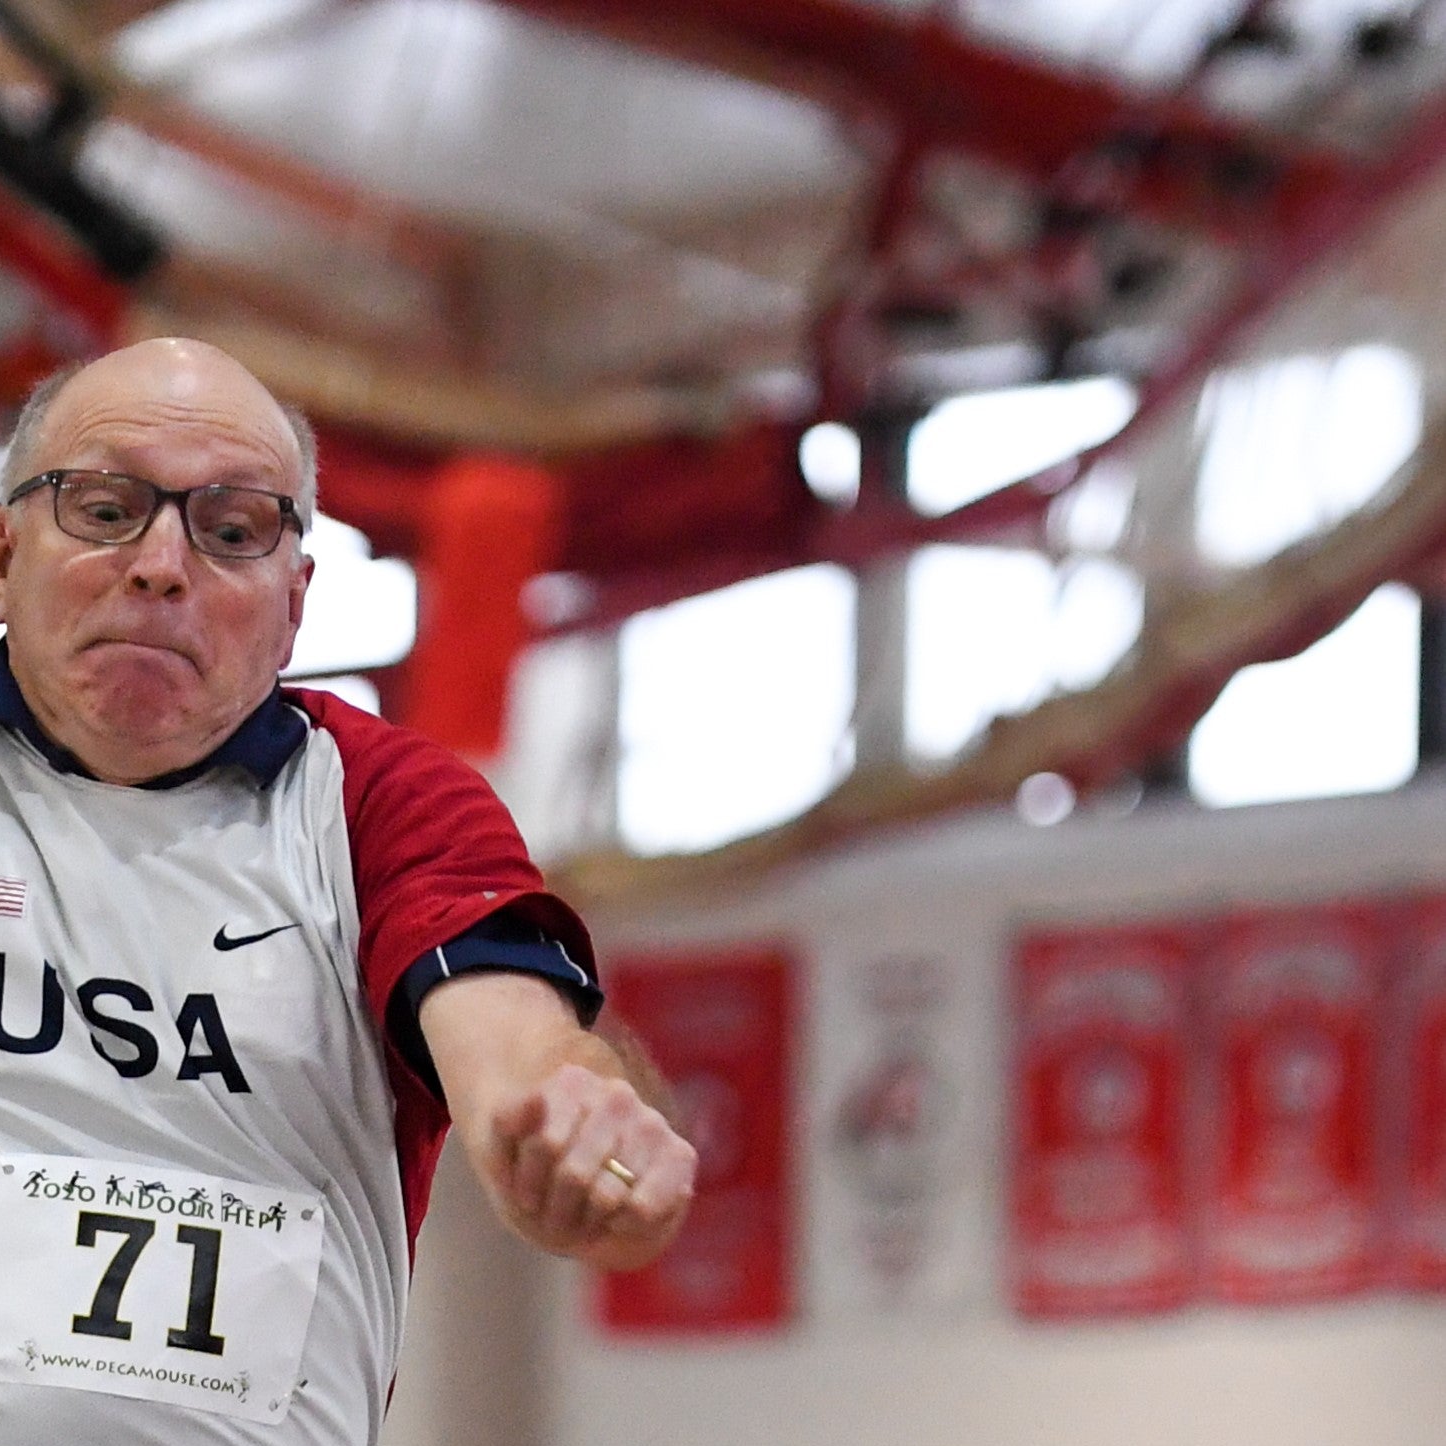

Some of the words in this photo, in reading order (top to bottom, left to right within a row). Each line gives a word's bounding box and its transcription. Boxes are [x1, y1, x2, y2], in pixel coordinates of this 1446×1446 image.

[24, 1175, 96, 1203] 2020
[105, 1186, 215, 1220] INDOOR
[71, 1210, 226, 1357] 71
[41, 1353, 235, 1394] WWW.DECAMOUSE.COM
